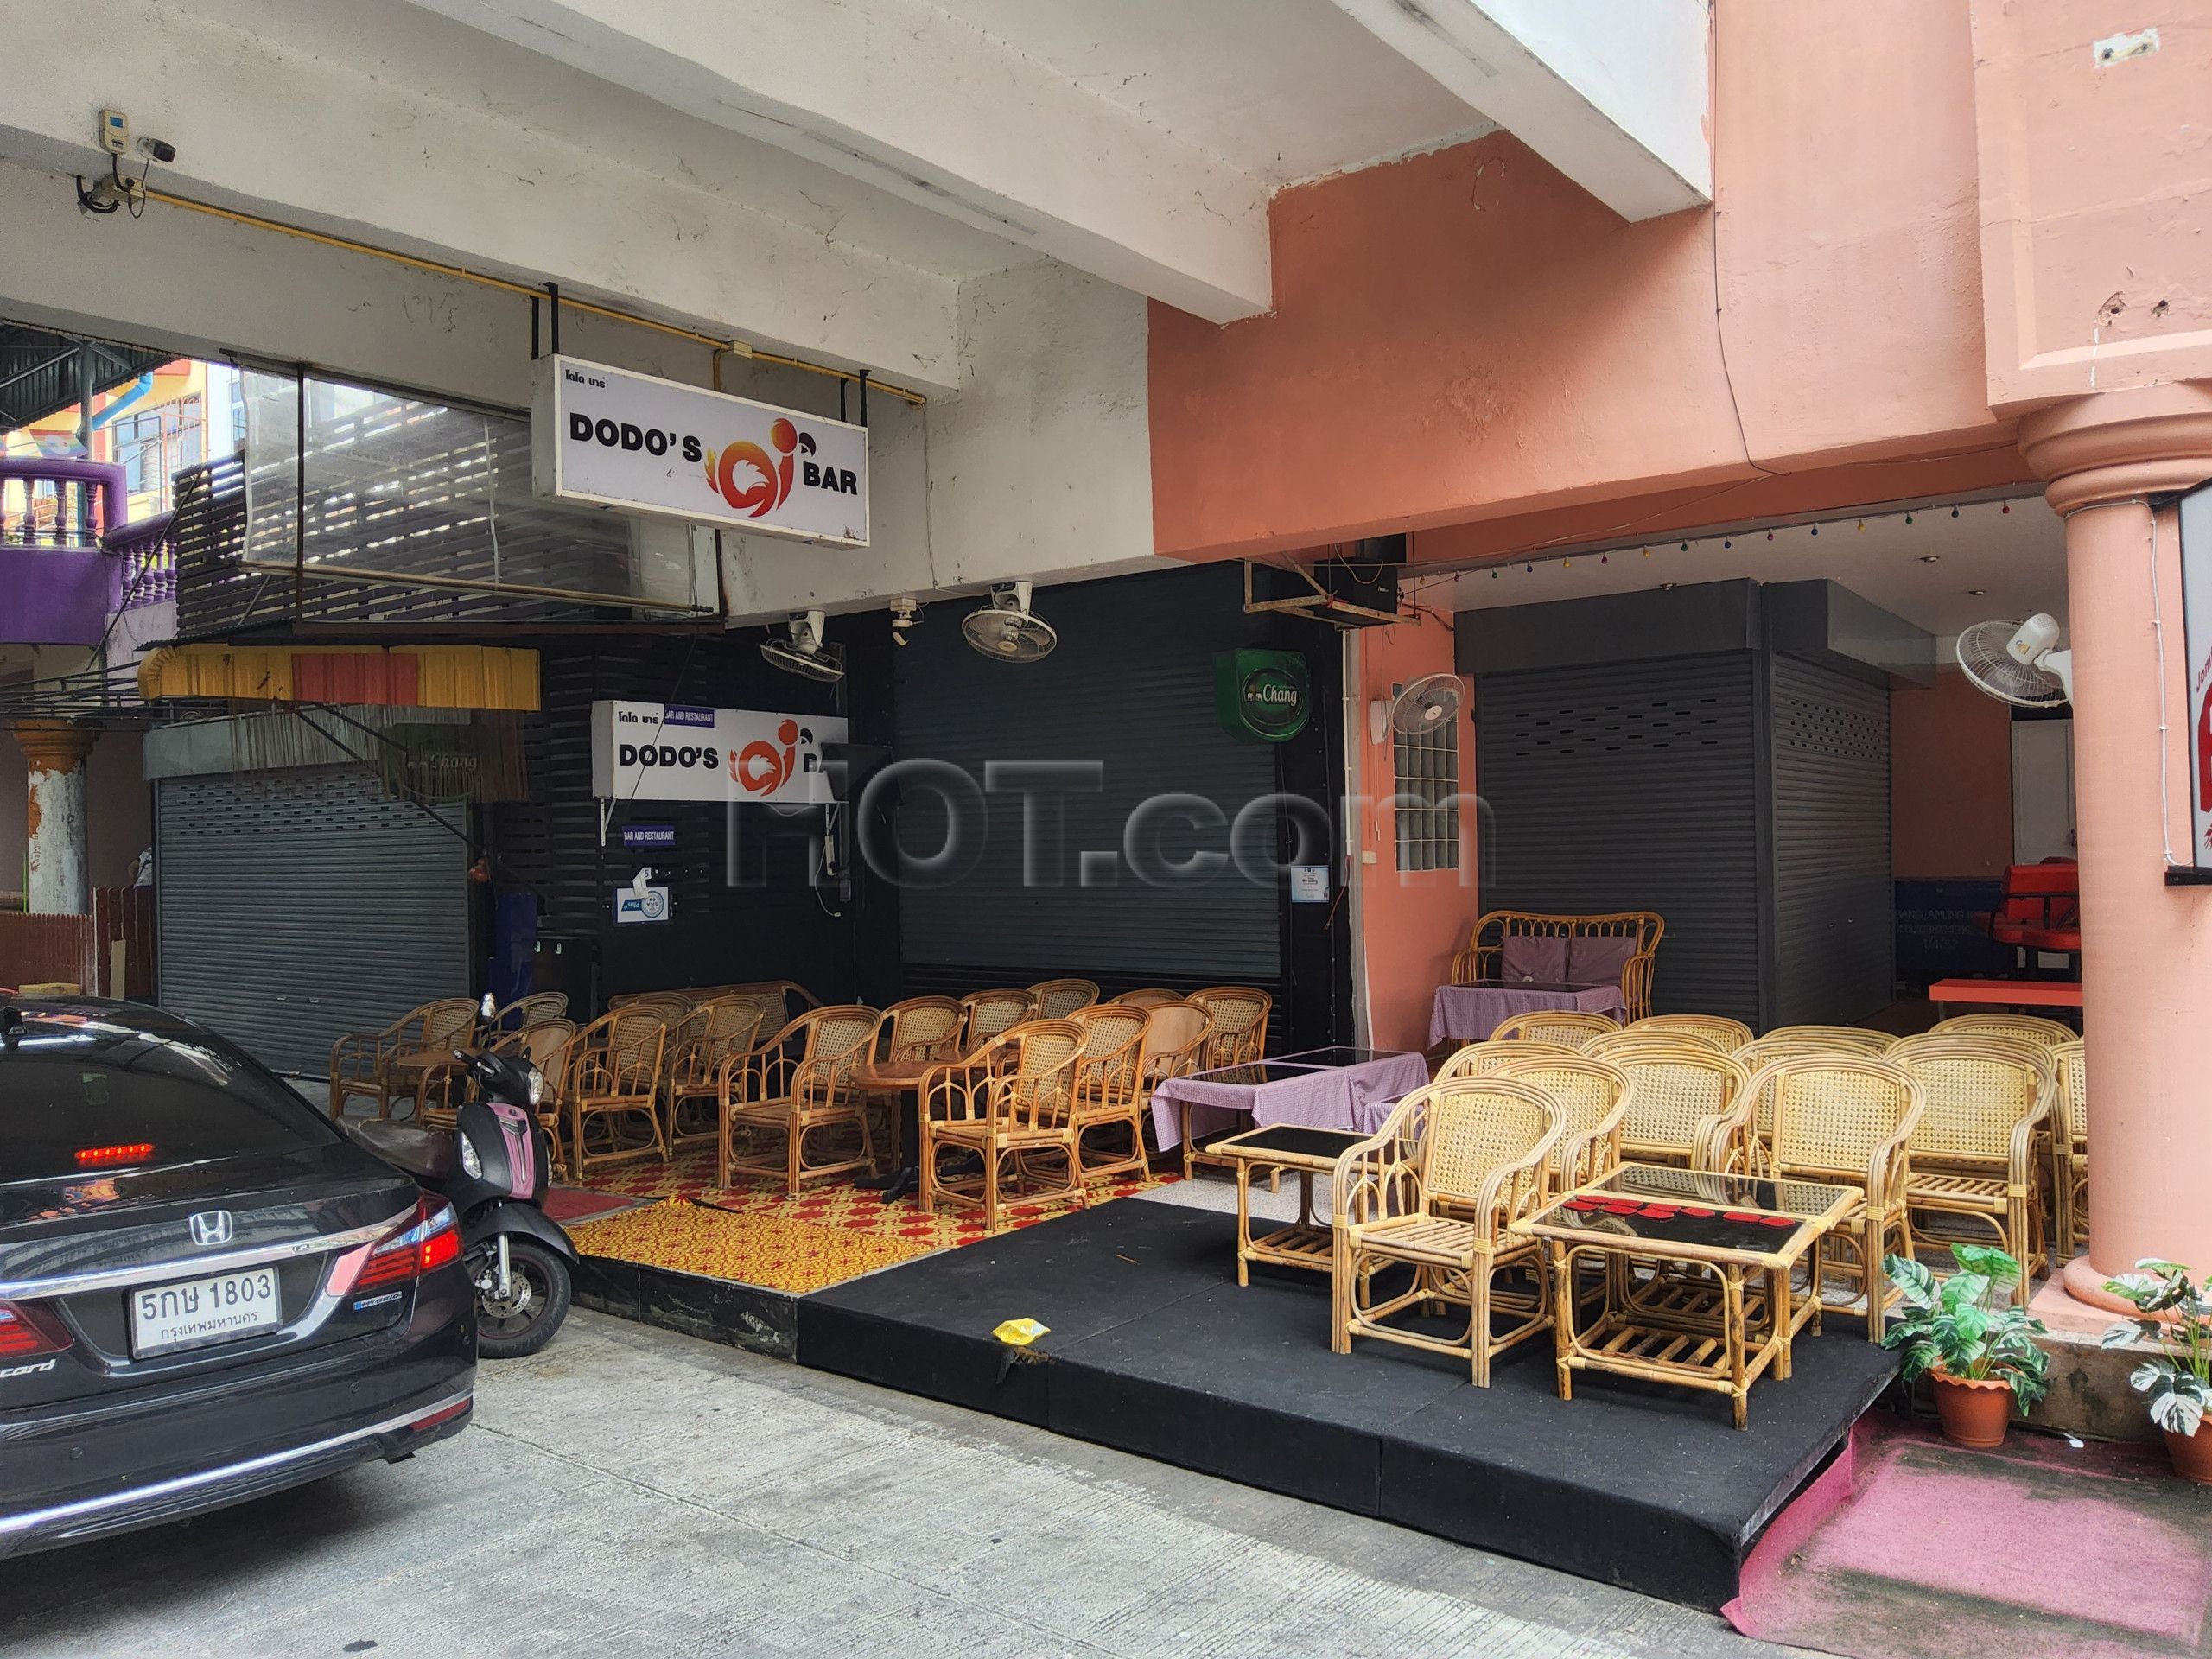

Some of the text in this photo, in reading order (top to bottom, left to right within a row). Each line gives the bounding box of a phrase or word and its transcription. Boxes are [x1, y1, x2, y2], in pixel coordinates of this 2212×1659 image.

[588, 377, 606, 388] บาร์
[569, 412, 858, 495] DODO'S BAR
[1263, 683, 1298, 707] Chang
[675, 710, 684, 721] AND
[685, 711, 714, 722] RESTAURANT
[619, 744, 719, 769] DODO'S
[624, 831, 674, 841] BAR AND RESTAURANT
[141, 1274, 270, 1320] 5กษ 1803
[160, 1311, 258, 1343] กรุงเทพมหานคร
